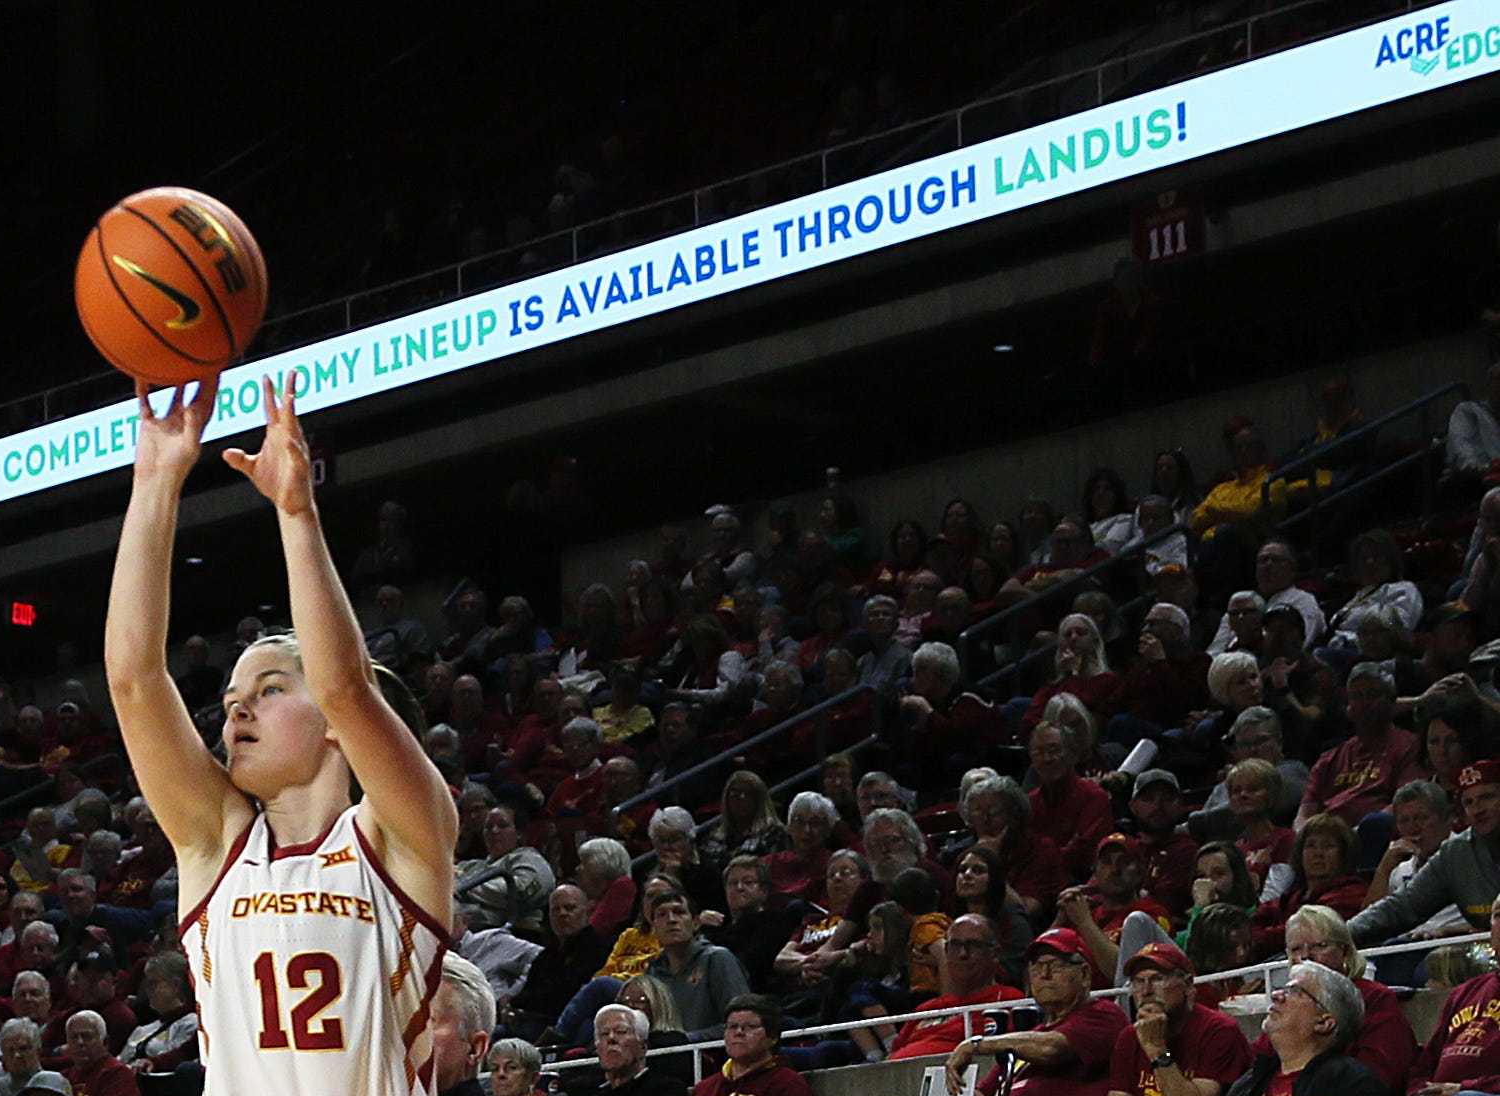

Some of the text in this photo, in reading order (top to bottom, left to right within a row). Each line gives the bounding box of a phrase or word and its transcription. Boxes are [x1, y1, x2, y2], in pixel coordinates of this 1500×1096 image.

[1375, 16, 1450, 68] ACRE
[1149, 221, 1187, 260] 111
[4, 411, 157, 482] COMPLET
[216, 347, 362, 422] RONOMY
[373, 308, 497, 376] LINEUP
[510, 295, 544, 336] IS
[556, 230, 760, 324] AVAILABLE
[774, 165, 976, 257] THROUGH
[995, 101, 1187, 195] LANDUS!
[254, 952, 346, 1052] 12
